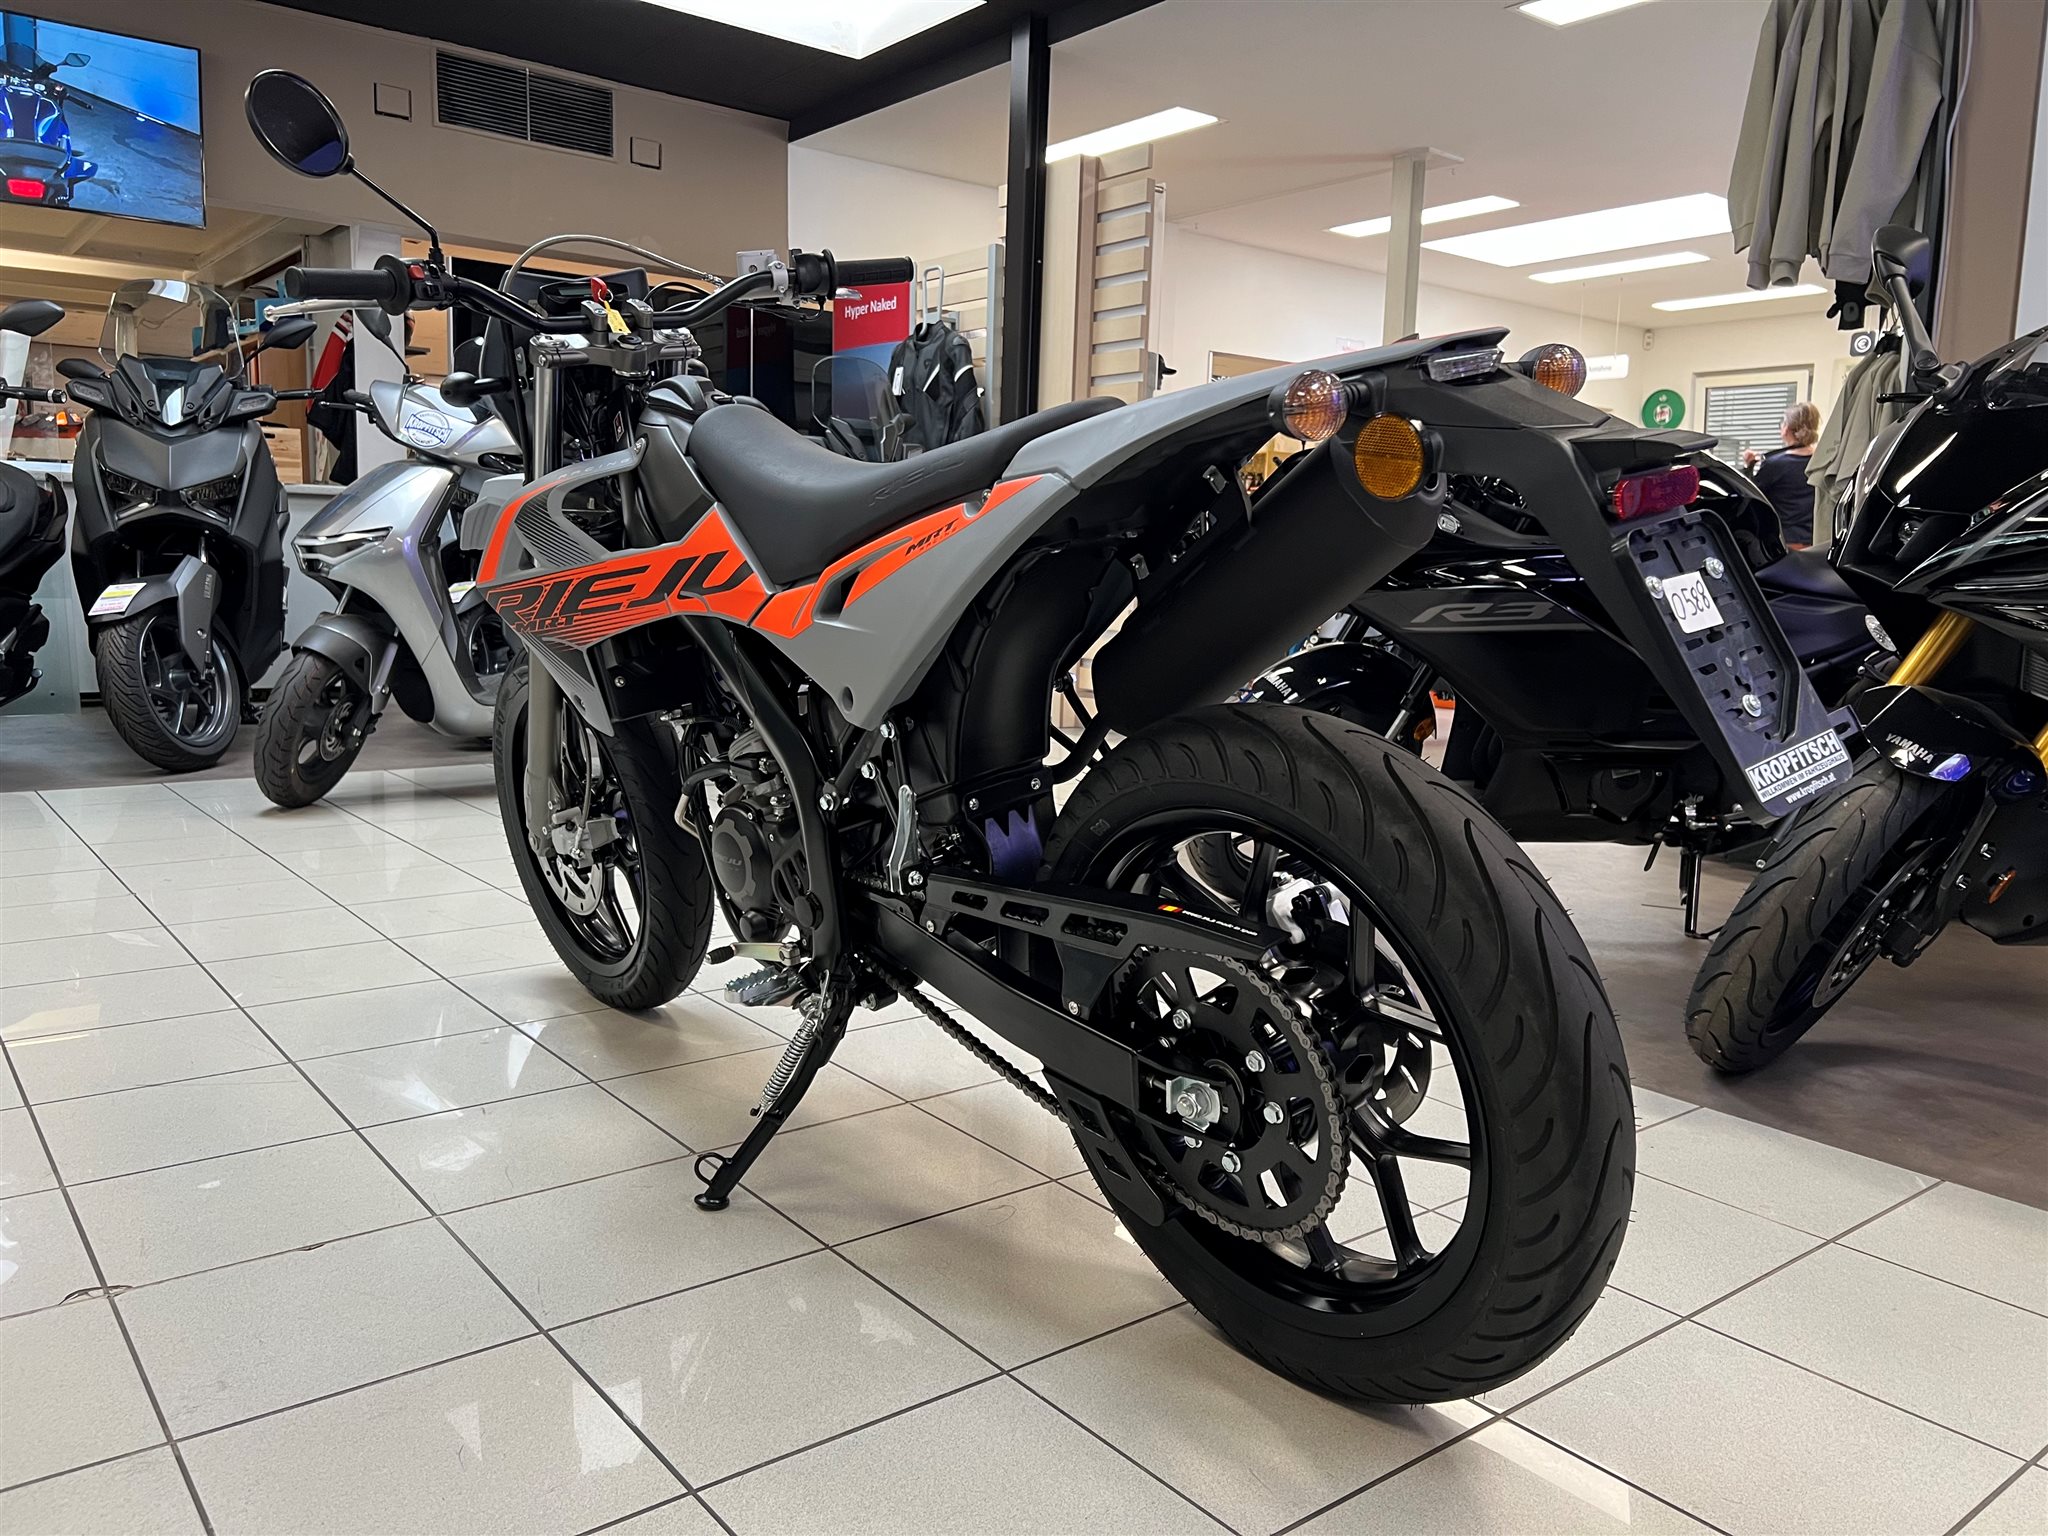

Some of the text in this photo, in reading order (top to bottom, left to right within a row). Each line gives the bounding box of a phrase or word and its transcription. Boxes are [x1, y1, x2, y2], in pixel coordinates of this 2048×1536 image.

[844, 296, 897, 320] Hyper Naked
[904, 517, 959, 555] MRT
[486, 550, 754, 624] RIEJU
[1671, 579, 1711, 620] 0588
[1410, 602, 1555, 625] R3
[1748, 731, 1841, 790] KROPFITSCH
[1885, 732, 1936, 765] YAMAHA
[1761, 752, 1846, 799] WILLKOMMEN IM FAHRZEUGHAUS
[1785, 771, 1837, 804] www.kropfitsch.at
